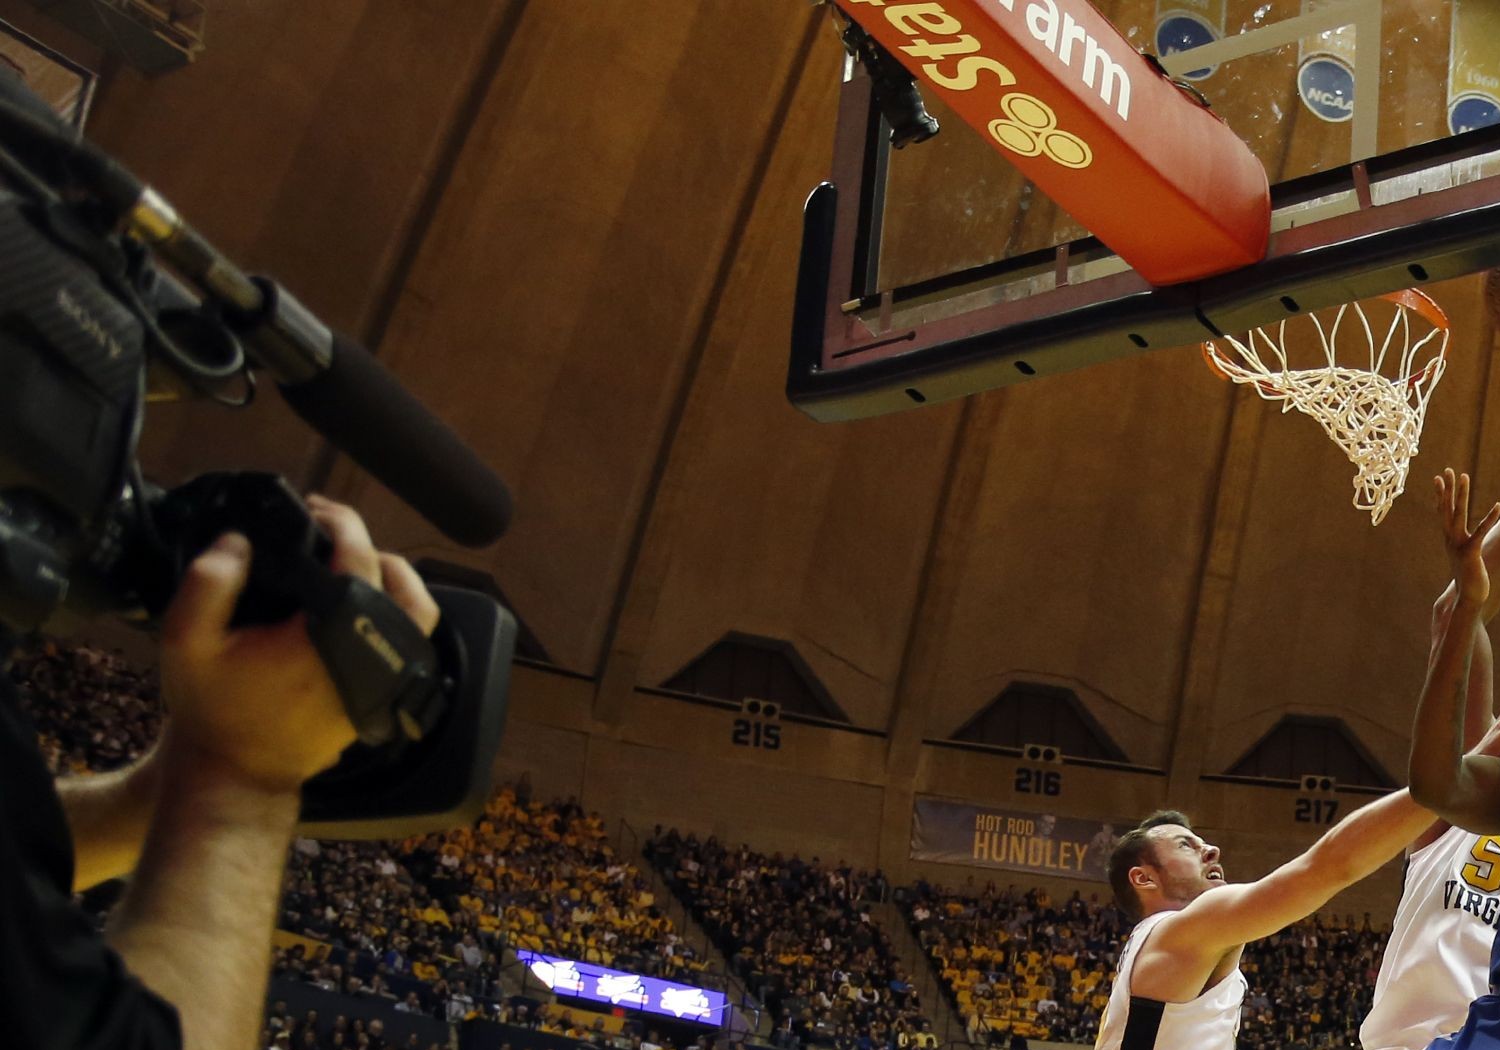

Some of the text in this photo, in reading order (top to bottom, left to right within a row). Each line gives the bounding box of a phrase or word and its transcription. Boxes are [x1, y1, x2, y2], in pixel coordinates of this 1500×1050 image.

[861, 0, 1017, 91] Sta
[998, 0, 1131, 122] arm
[732, 719, 782, 750] 215
[1015, 767, 1062, 797] 216
[975, 814, 1034, 836] HOT ROD
[1295, 797, 1340, 825] 217
[973, 831, 1088, 871] HUNDLEY
